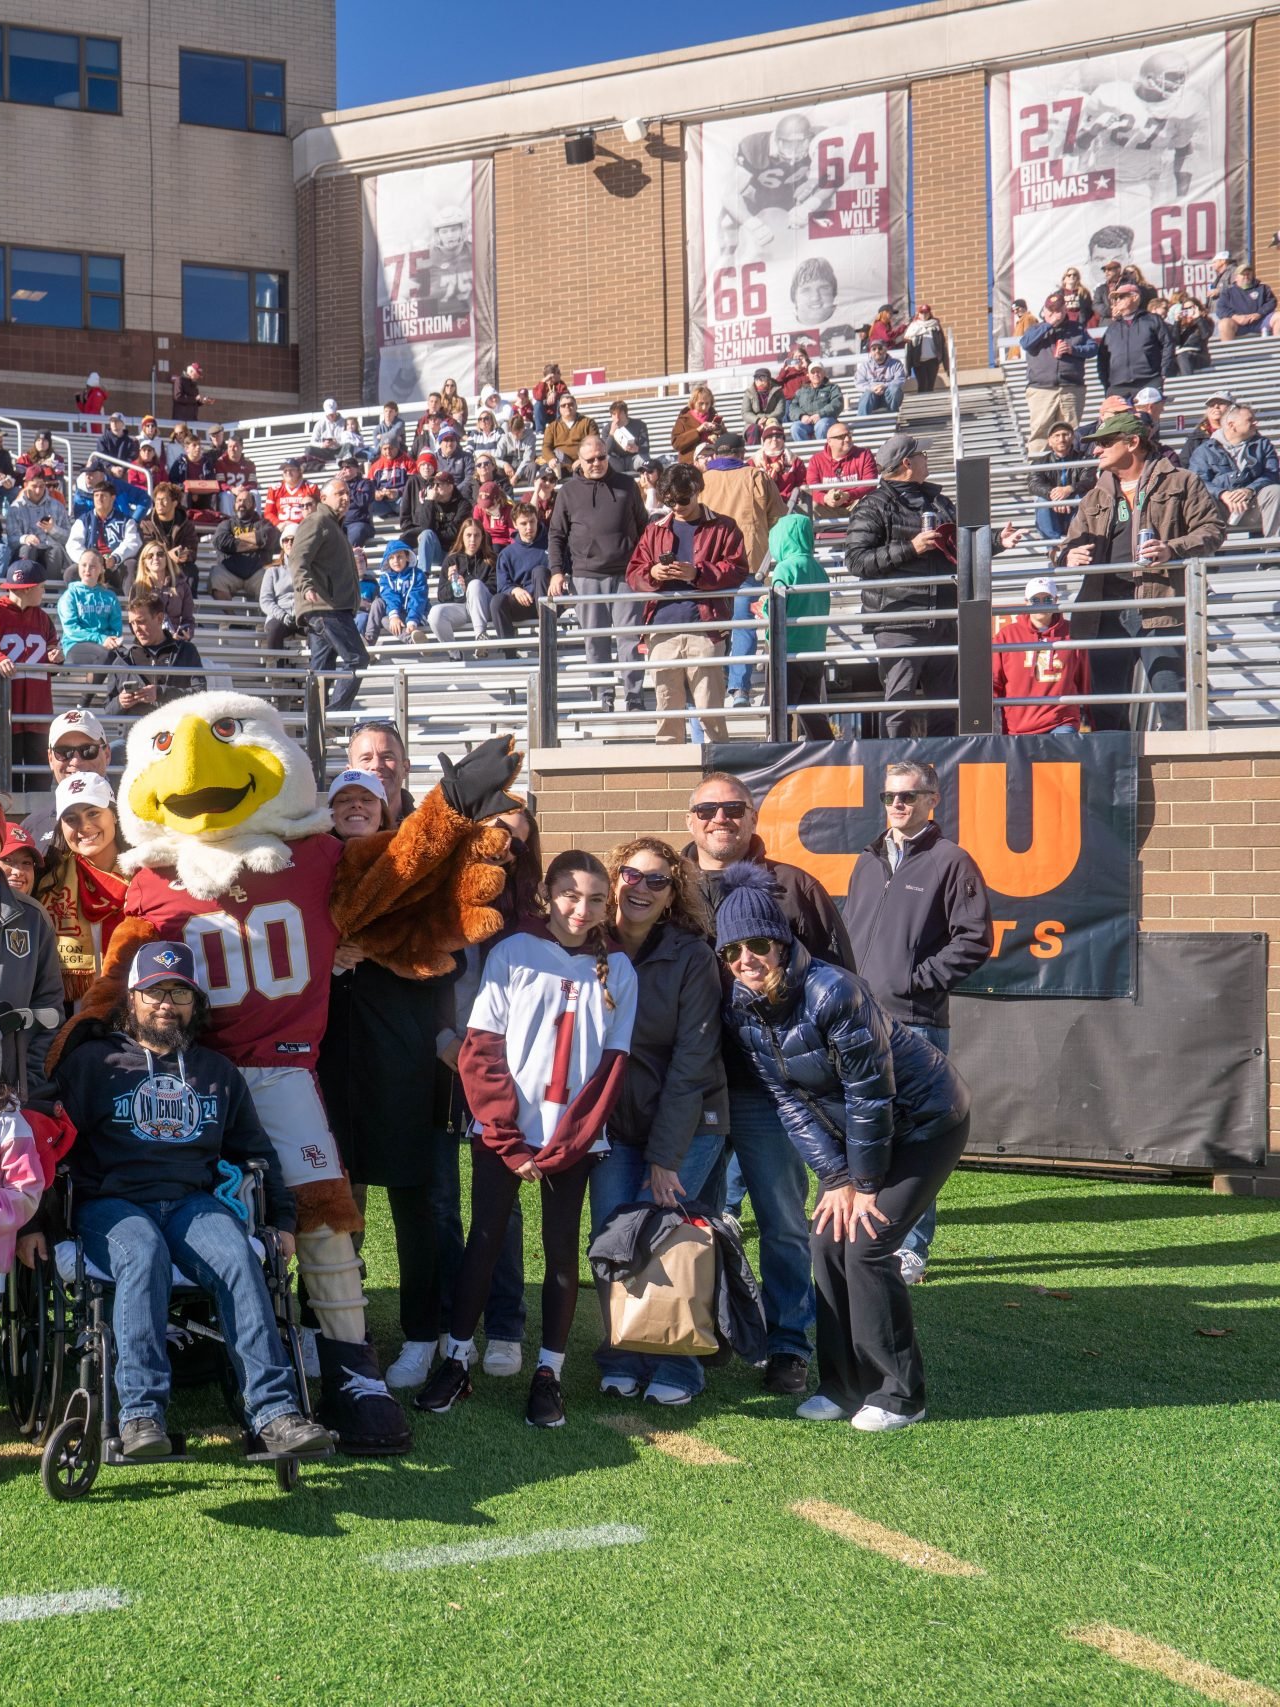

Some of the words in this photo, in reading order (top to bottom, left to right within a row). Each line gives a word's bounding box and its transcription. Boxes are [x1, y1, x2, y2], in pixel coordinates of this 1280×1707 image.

[1020, 97, 1084, 162] 27
[819, 132, 879, 189] 64
[1021, 161, 1054, 187] BILL
[852, 189, 880, 208] JOE
[1021, 175, 1089, 206] THOMAS
[839, 209, 880, 229] WOLF
[1151, 201, 1217, 264] 60
[384, 249, 430, 301] 75
[1183, 264, 1217, 285] BOB
[714, 262, 767, 321] 66
[383, 302, 418, 322] CHRIS
[383, 315, 453, 340] LINDSTROM
[715, 320, 757, 343] STEVE
[714, 334, 791, 361] SCHINDLER
[105, 521, 126, 546] N
[0, 633, 48, 680] 22
[182, 900, 311, 1008] 00
[543, 1011, 575, 1104] 1
[115, 1098, 130, 1118] 20
[203, 1101, 218, 1119] 24
[139, 1093, 195, 1127] KNCKOUS
